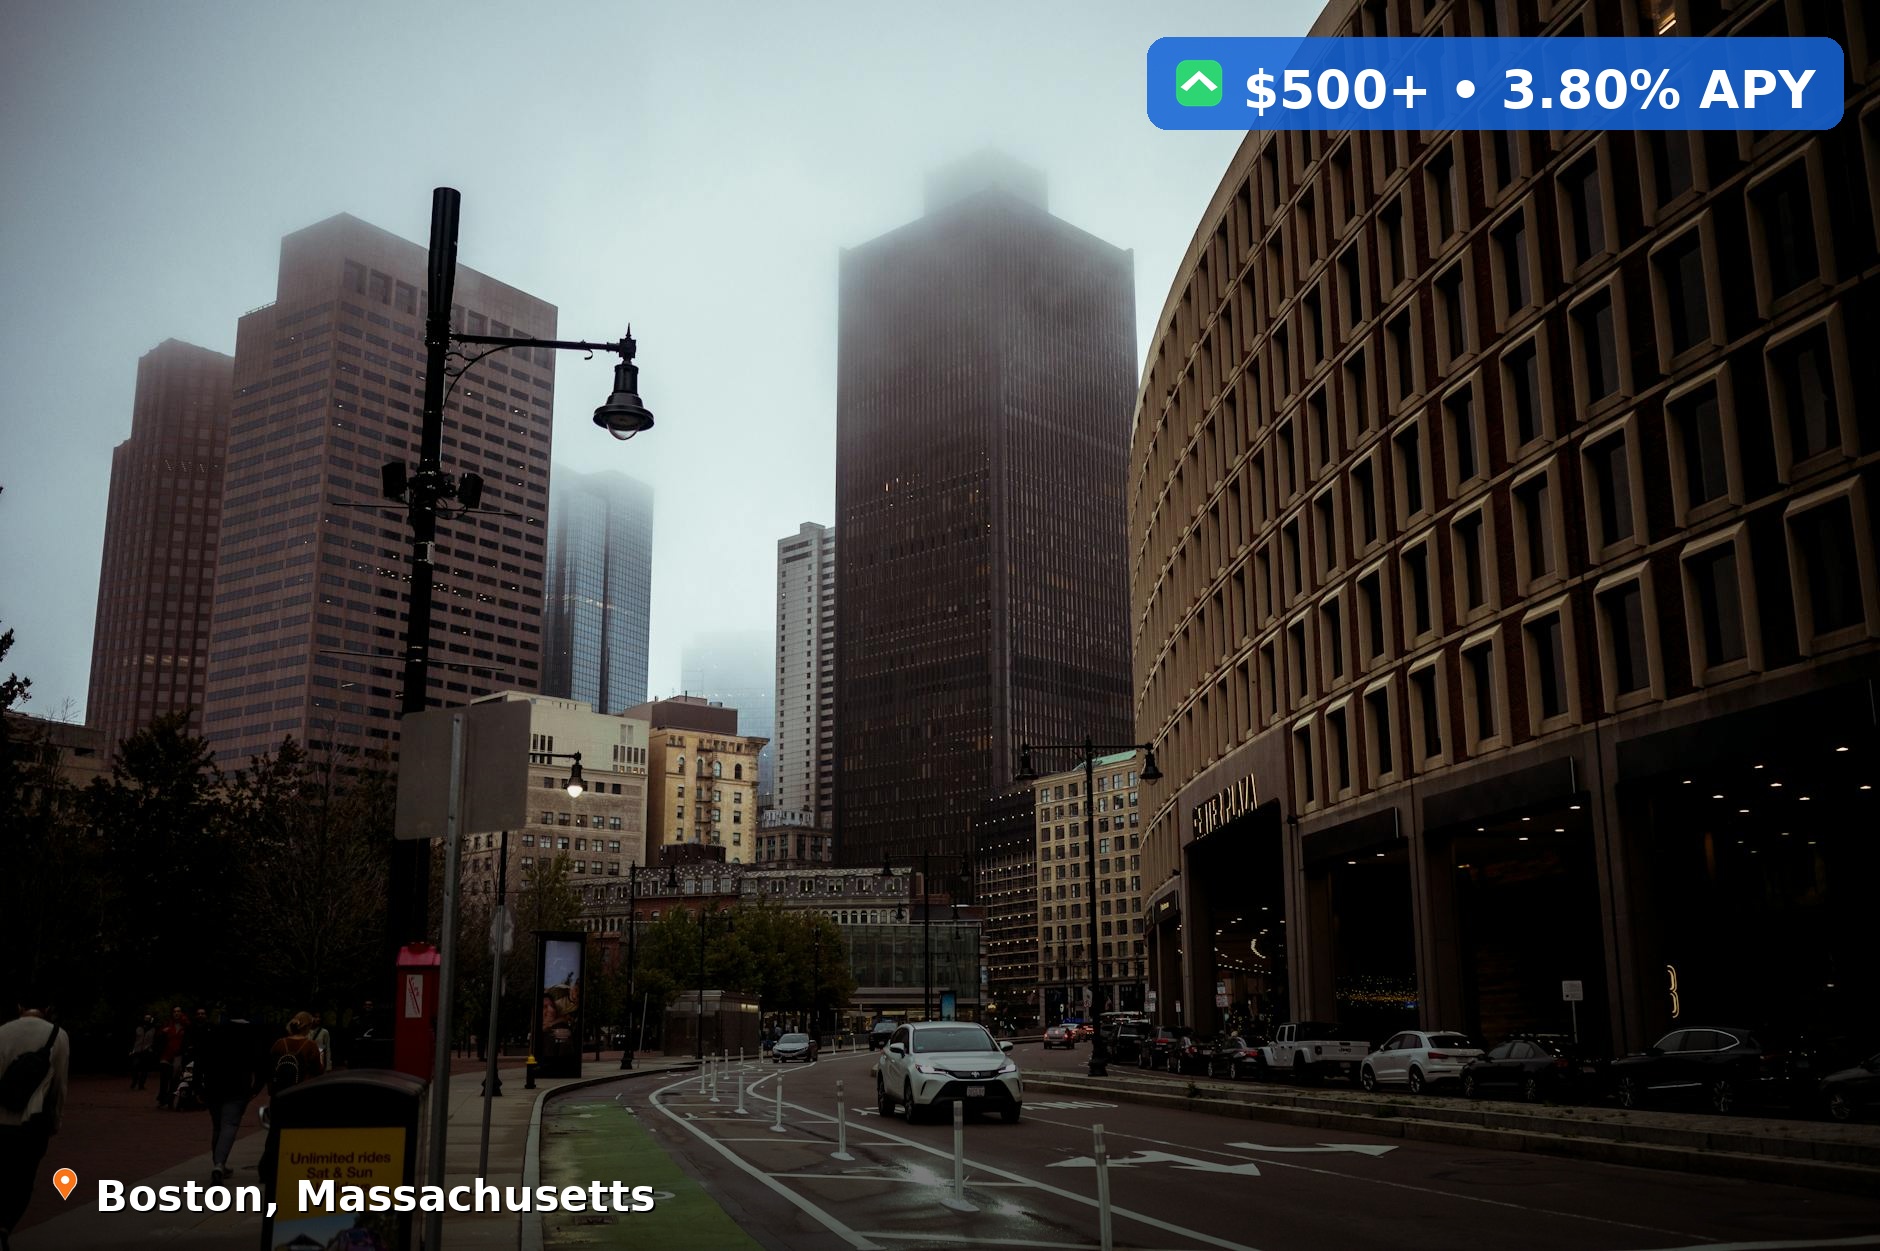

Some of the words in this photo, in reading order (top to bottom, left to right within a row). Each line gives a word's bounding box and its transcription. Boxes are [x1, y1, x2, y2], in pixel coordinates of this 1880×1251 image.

[290, 1152, 354, 1165] Unlimited
[357, 1152, 391, 1164] rides
[306, 1167, 330, 1179] Sat
[332, 1167, 342, 1178] &
[346, 1166, 373, 1179] Sun
